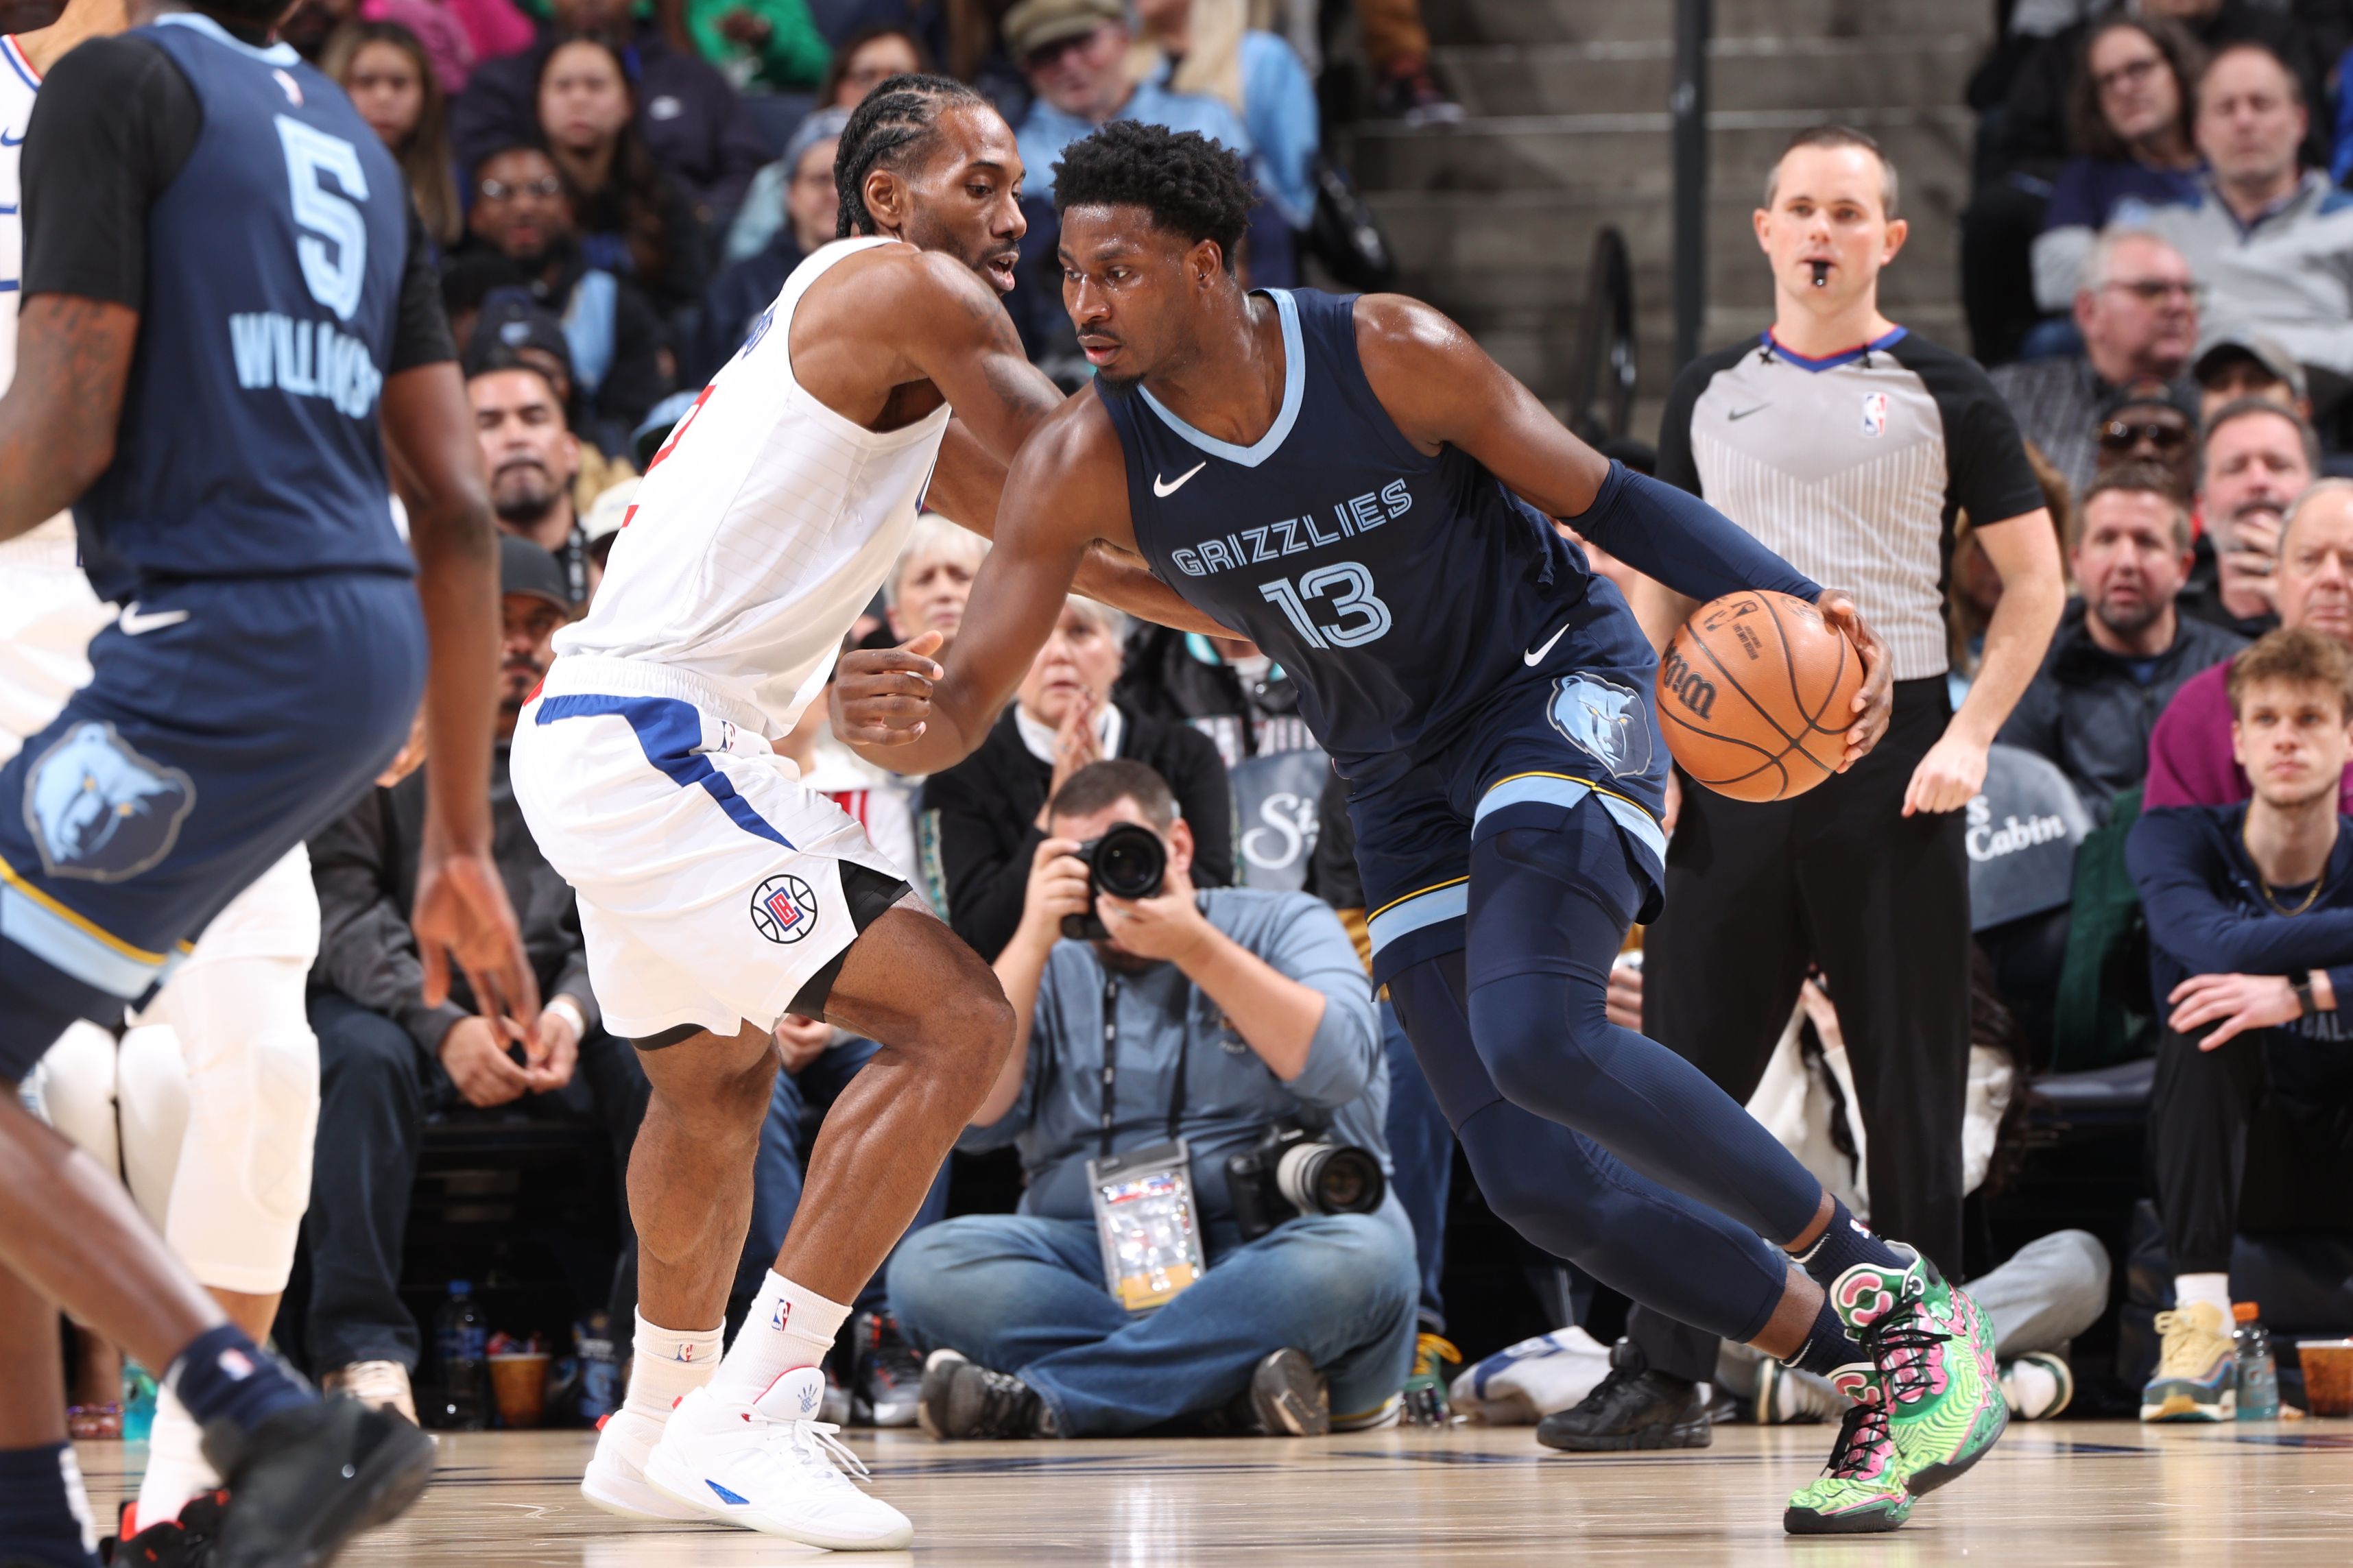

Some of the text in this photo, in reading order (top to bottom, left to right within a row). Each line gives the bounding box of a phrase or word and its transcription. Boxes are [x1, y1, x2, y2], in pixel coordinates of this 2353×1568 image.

[274, 113, 370, 321] 5
[228, 312, 383, 420] WILLI
[1171, 478, 1413, 577] GRIZZLIES
[1258, 562, 1392, 650] 13
[1965, 815, 2066, 862] Cabin
